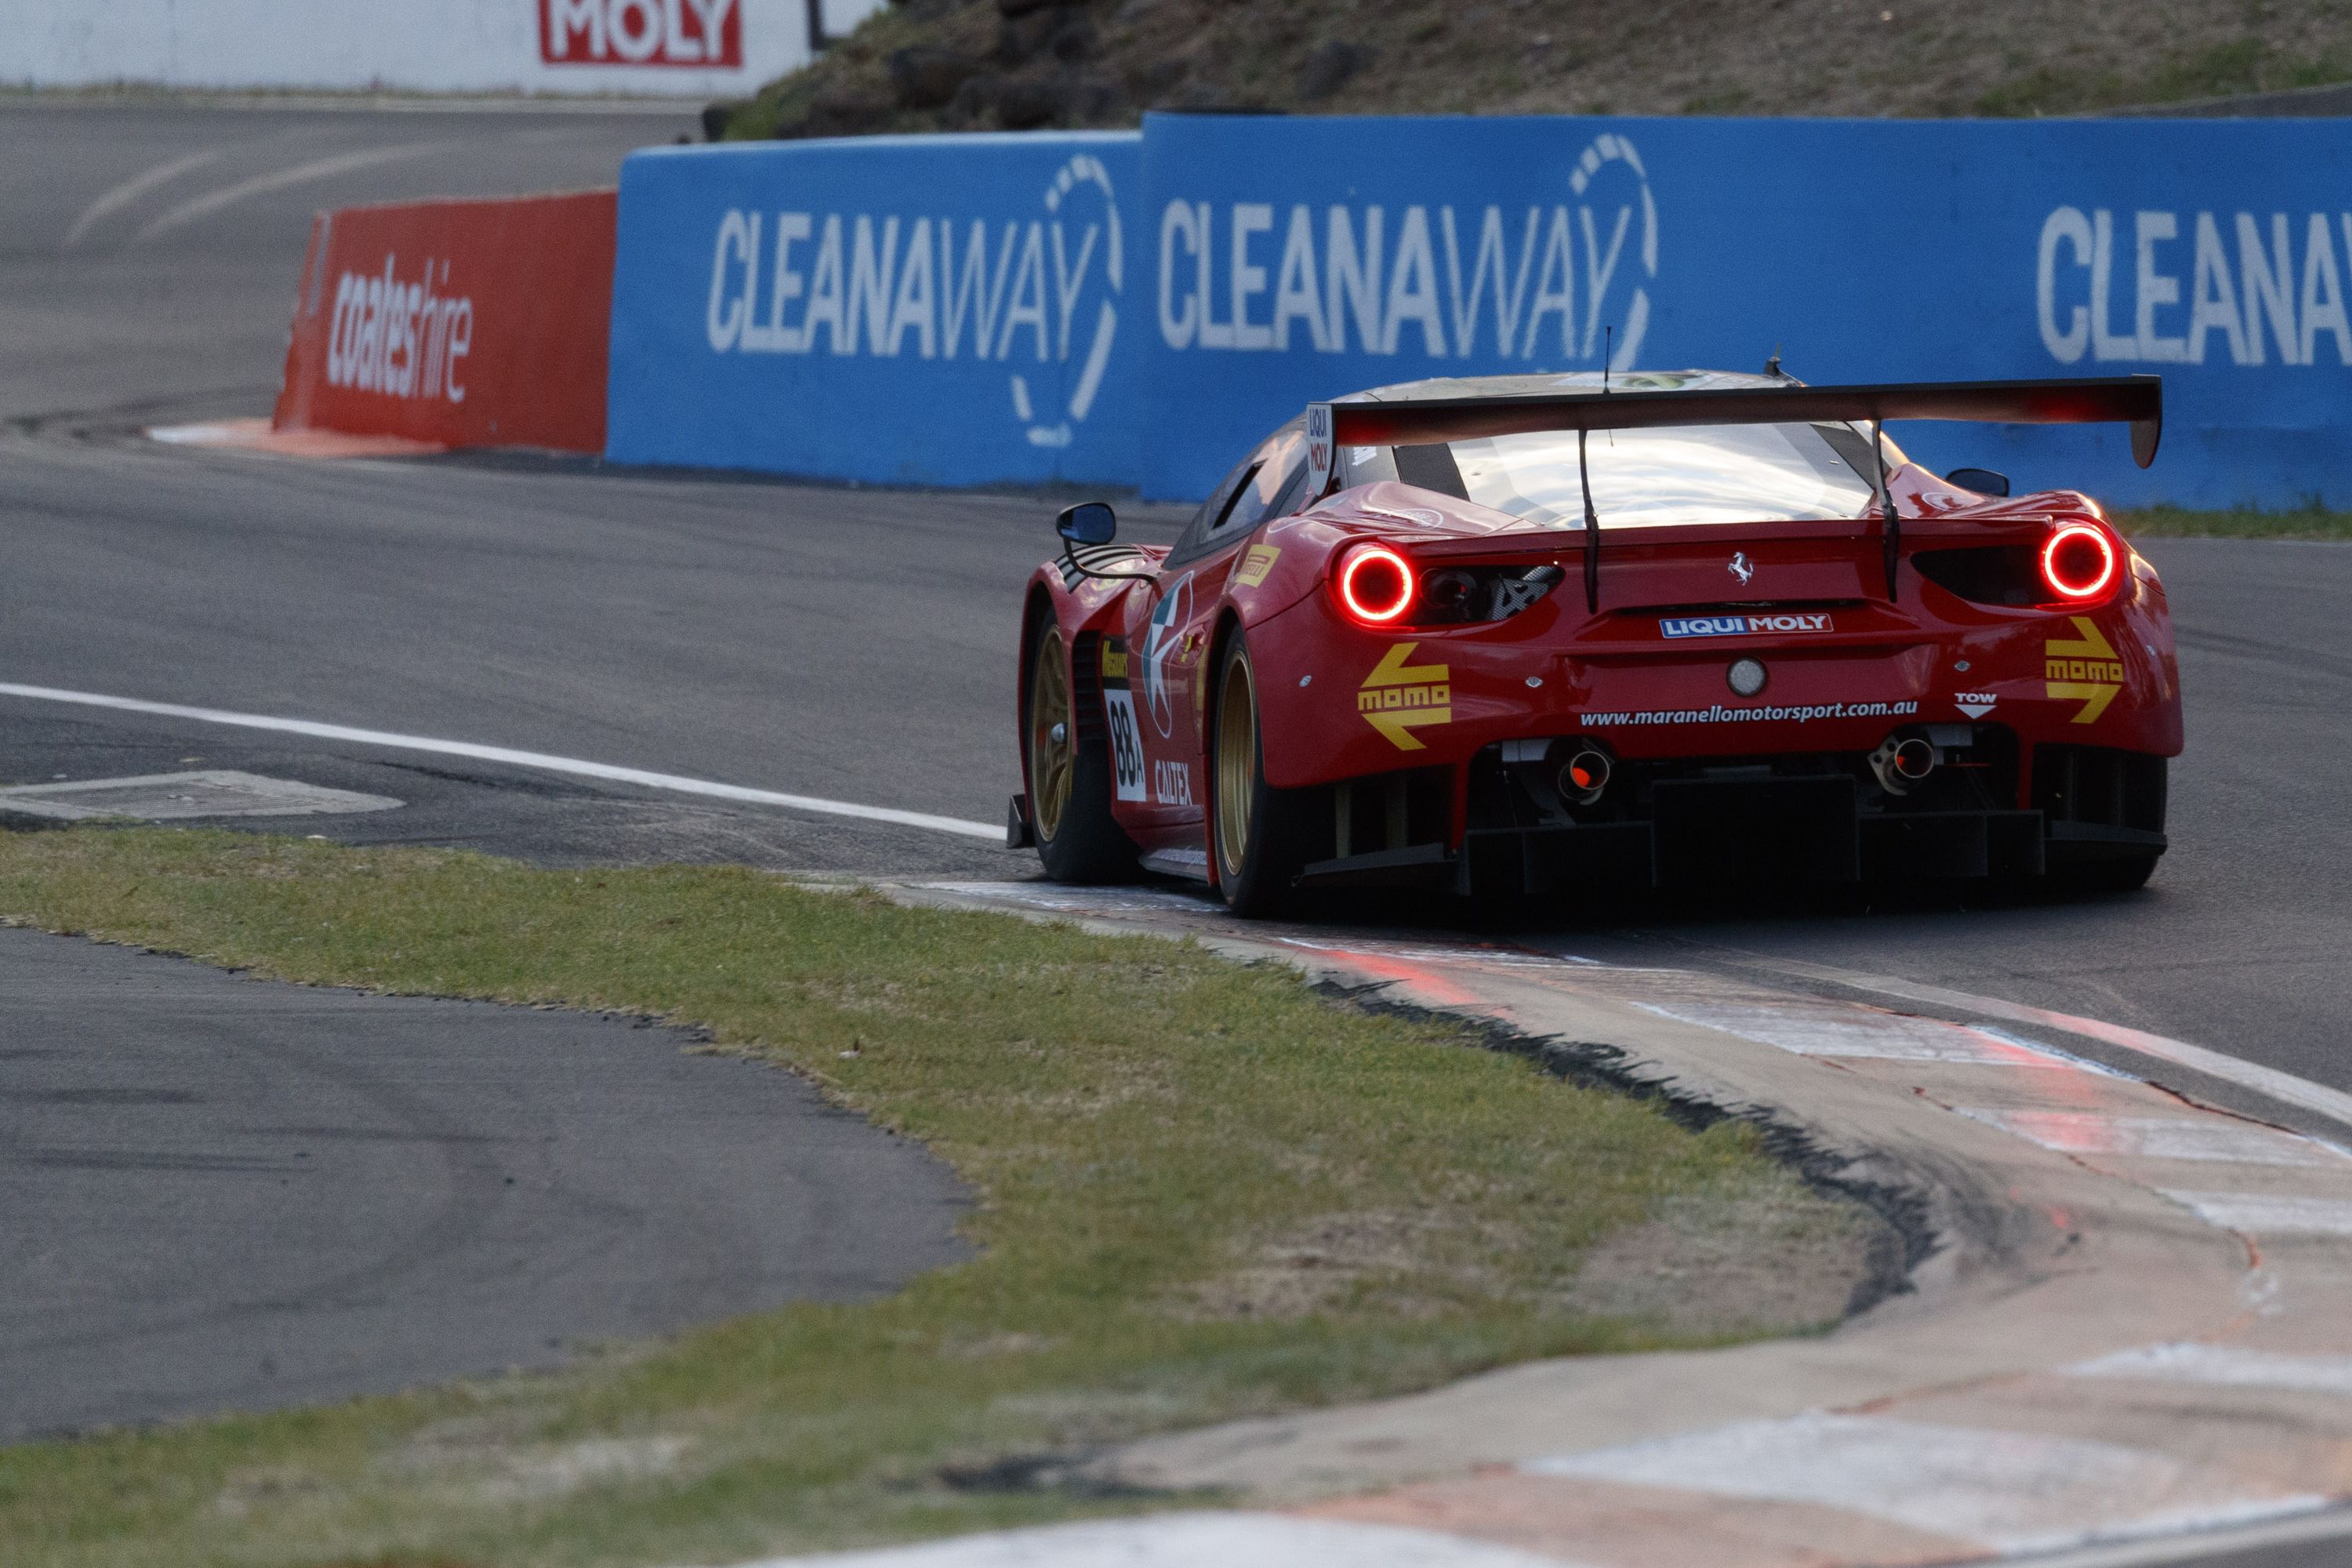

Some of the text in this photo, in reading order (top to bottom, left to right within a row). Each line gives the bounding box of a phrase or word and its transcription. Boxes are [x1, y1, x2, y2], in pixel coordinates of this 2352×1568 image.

[550, 0, 735, 62] MOLY
[706, 208, 1098, 362] CLEANAWAY
[1158, 198, 1632, 360] CLEANAWAY
[2036, 205, 2352, 366] CLEANA
[1309, 408, 1327, 438] LIQUI
[1310, 441, 1327, 472] MOLY
[1664, 613, 1827, 636] LIQUI MOLY
[1580, 701, 1918, 727] www.maranellomotorsport.com.au
[1954, 692, 1998, 703] TOW
[1155, 759, 1193, 807] CALTEX
